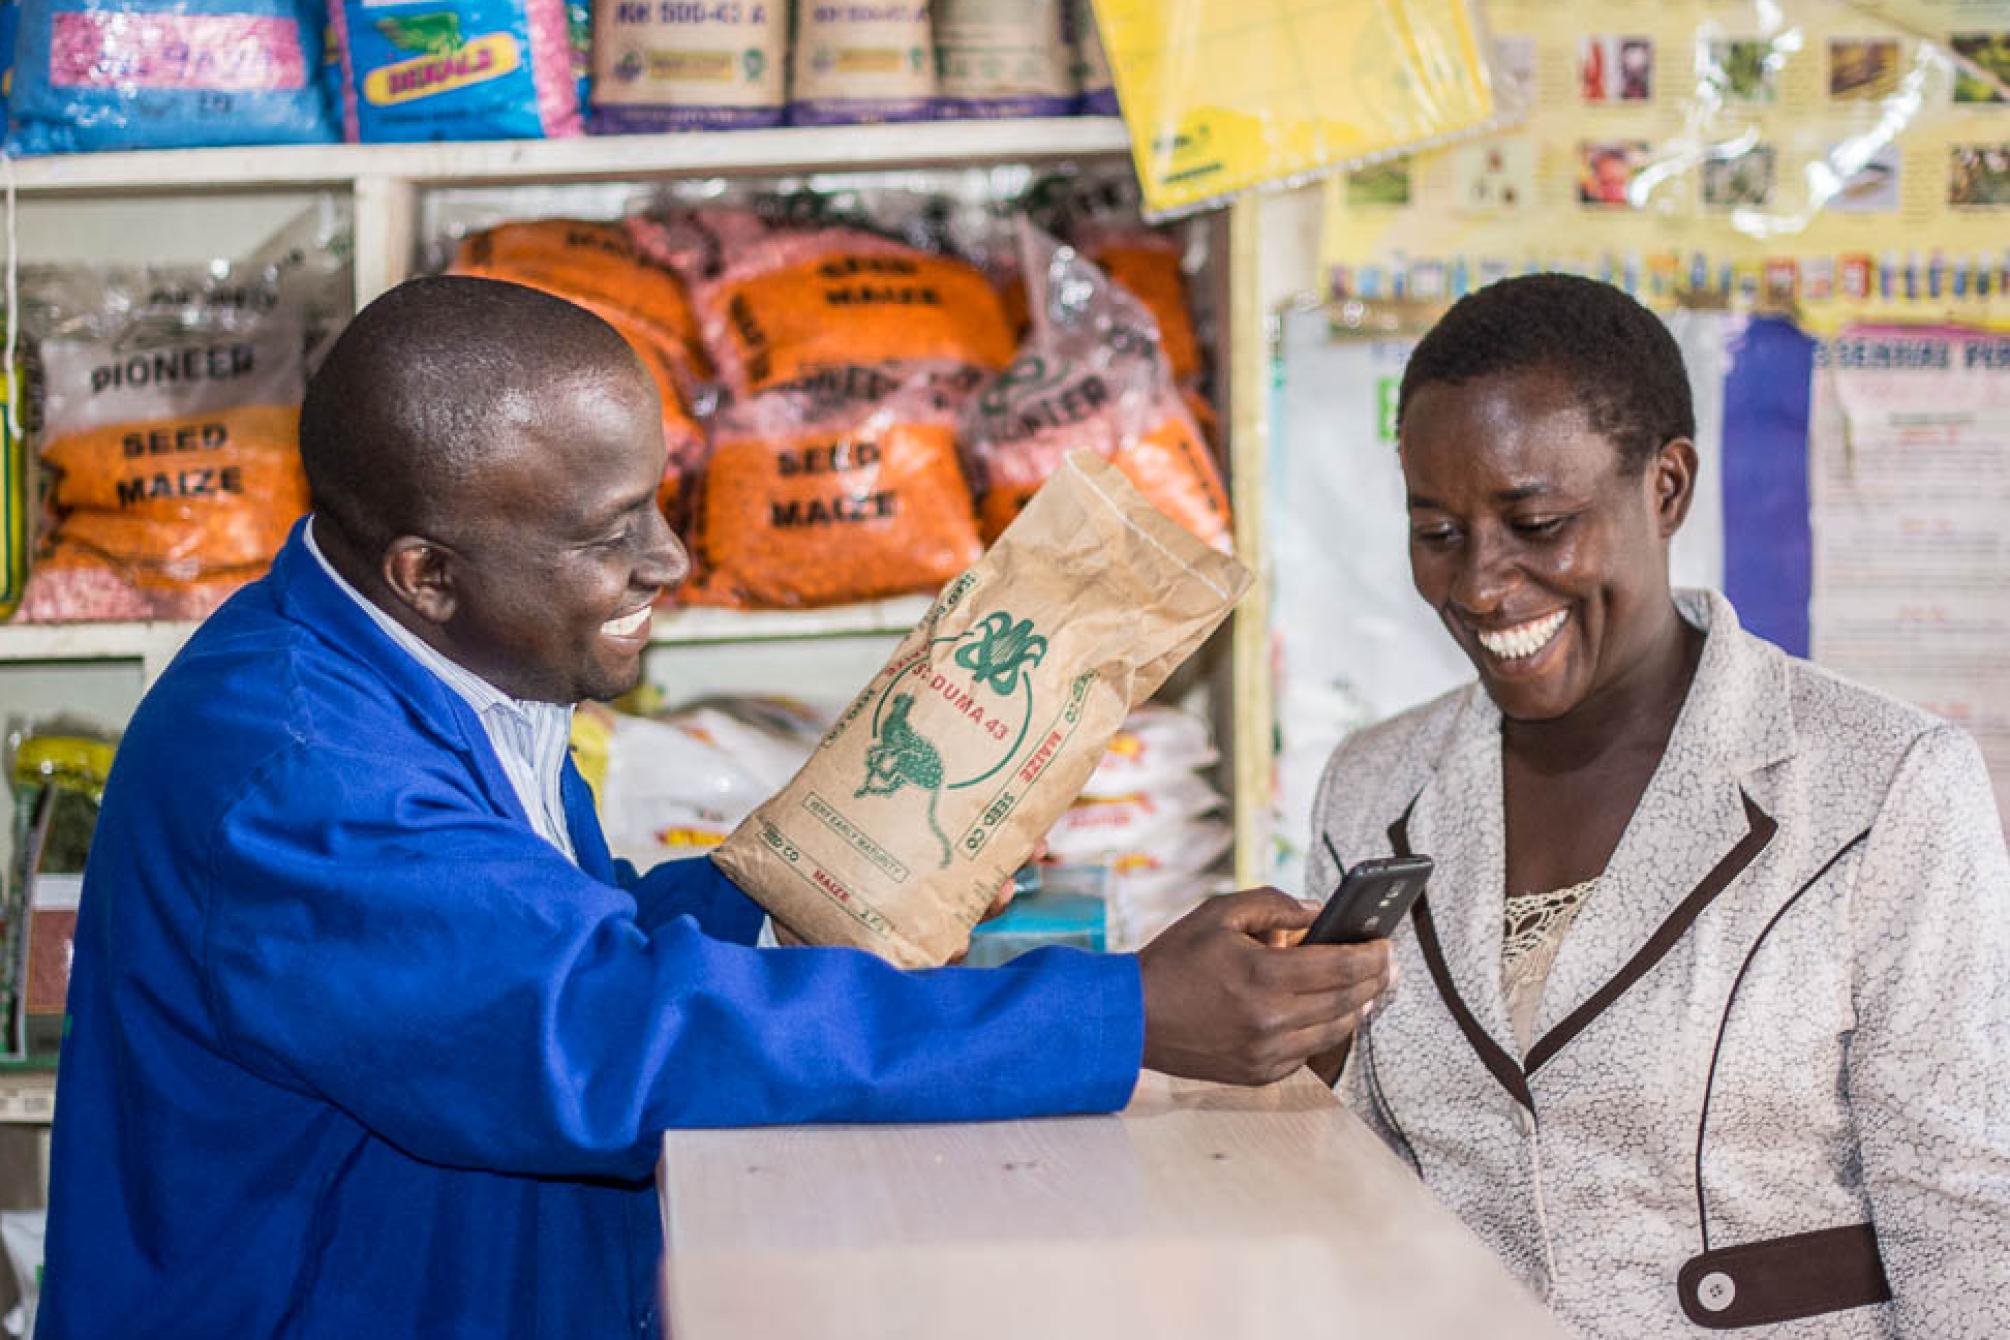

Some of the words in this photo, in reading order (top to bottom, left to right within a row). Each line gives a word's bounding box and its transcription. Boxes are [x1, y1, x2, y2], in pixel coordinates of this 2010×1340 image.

[122, 421, 229, 459] SEED
[116, 466, 245, 508] MAIZE
[769, 488, 899, 530] MAIZE
[929, 673, 985, 725] DUMA
[984, 718, 1009, 741] 43
[1018, 730, 1063, 784] MAIZE
[983, 790, 1016, 827] SEED
[966, 827, 986, 850] CO
[811, 868, 850, 903] MAIZE
